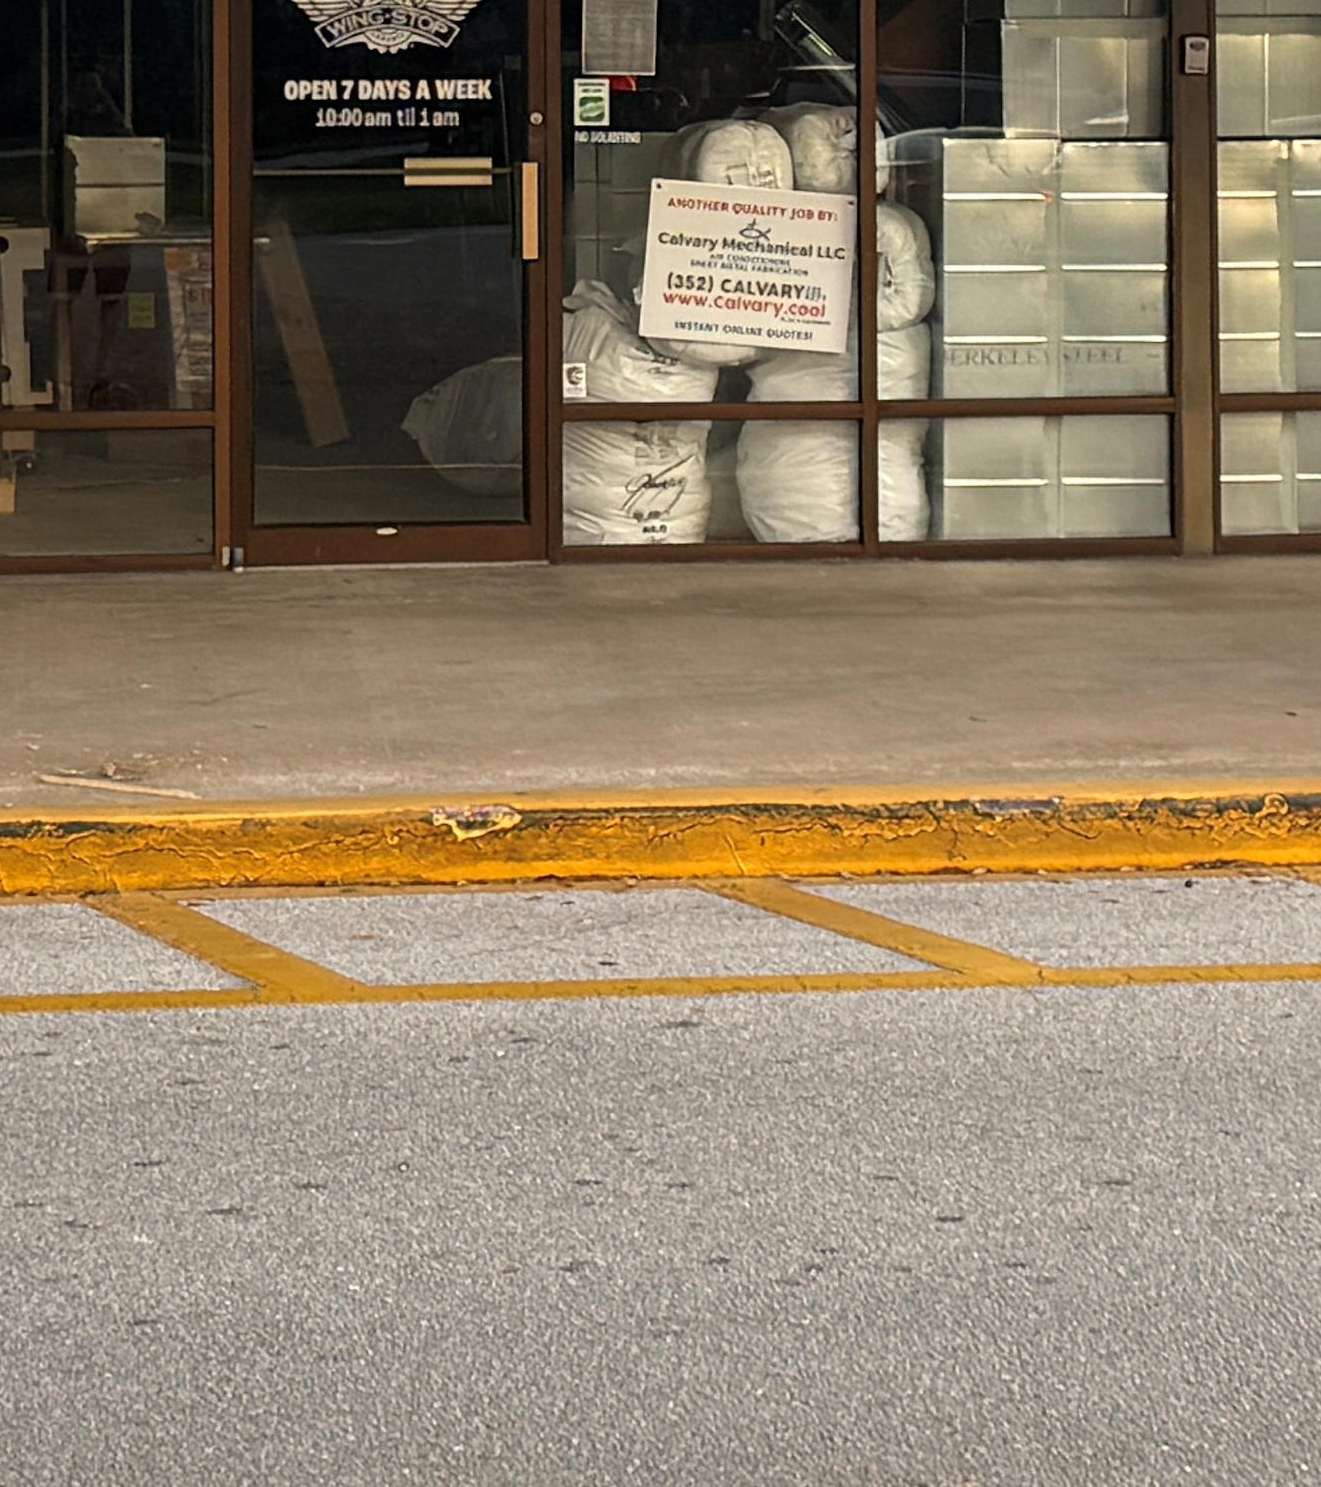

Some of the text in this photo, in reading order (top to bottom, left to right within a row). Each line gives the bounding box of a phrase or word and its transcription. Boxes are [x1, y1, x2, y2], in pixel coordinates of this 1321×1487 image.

[283, 79, 493, 101] OPEN 7 DAYS A WEEK
[396, 106, 416, 127] til
[667, 197, 729, 212] ANOTHER
[732, 202, 787, 218] QUALITY
[789, 206, 815, 221] JOB
[657, 231, 847, 260] Calvary Mechanical LLC
[666, 271, 714, 293] (352)
[662, 292, 827, 318] www.Calvary.cool
